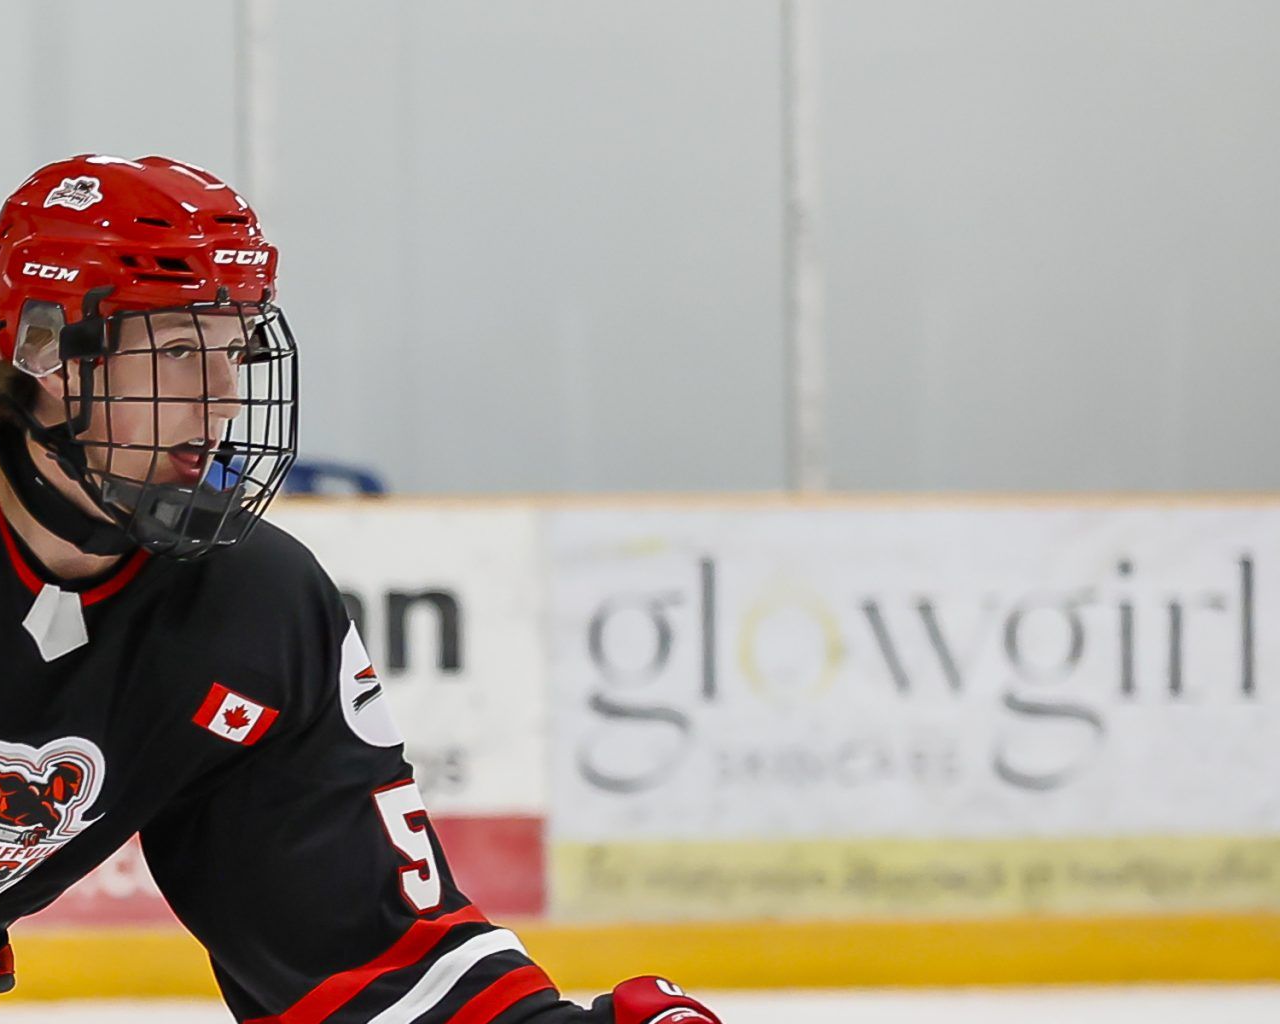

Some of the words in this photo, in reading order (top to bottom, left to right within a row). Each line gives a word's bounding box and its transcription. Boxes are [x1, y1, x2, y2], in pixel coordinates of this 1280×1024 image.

[22, 262, 80, 282] CCM
[213, 249, 269, 265] CCM
[577, 552, 1256, 794] glowgirl
[372, 778, 443, 915] 5
